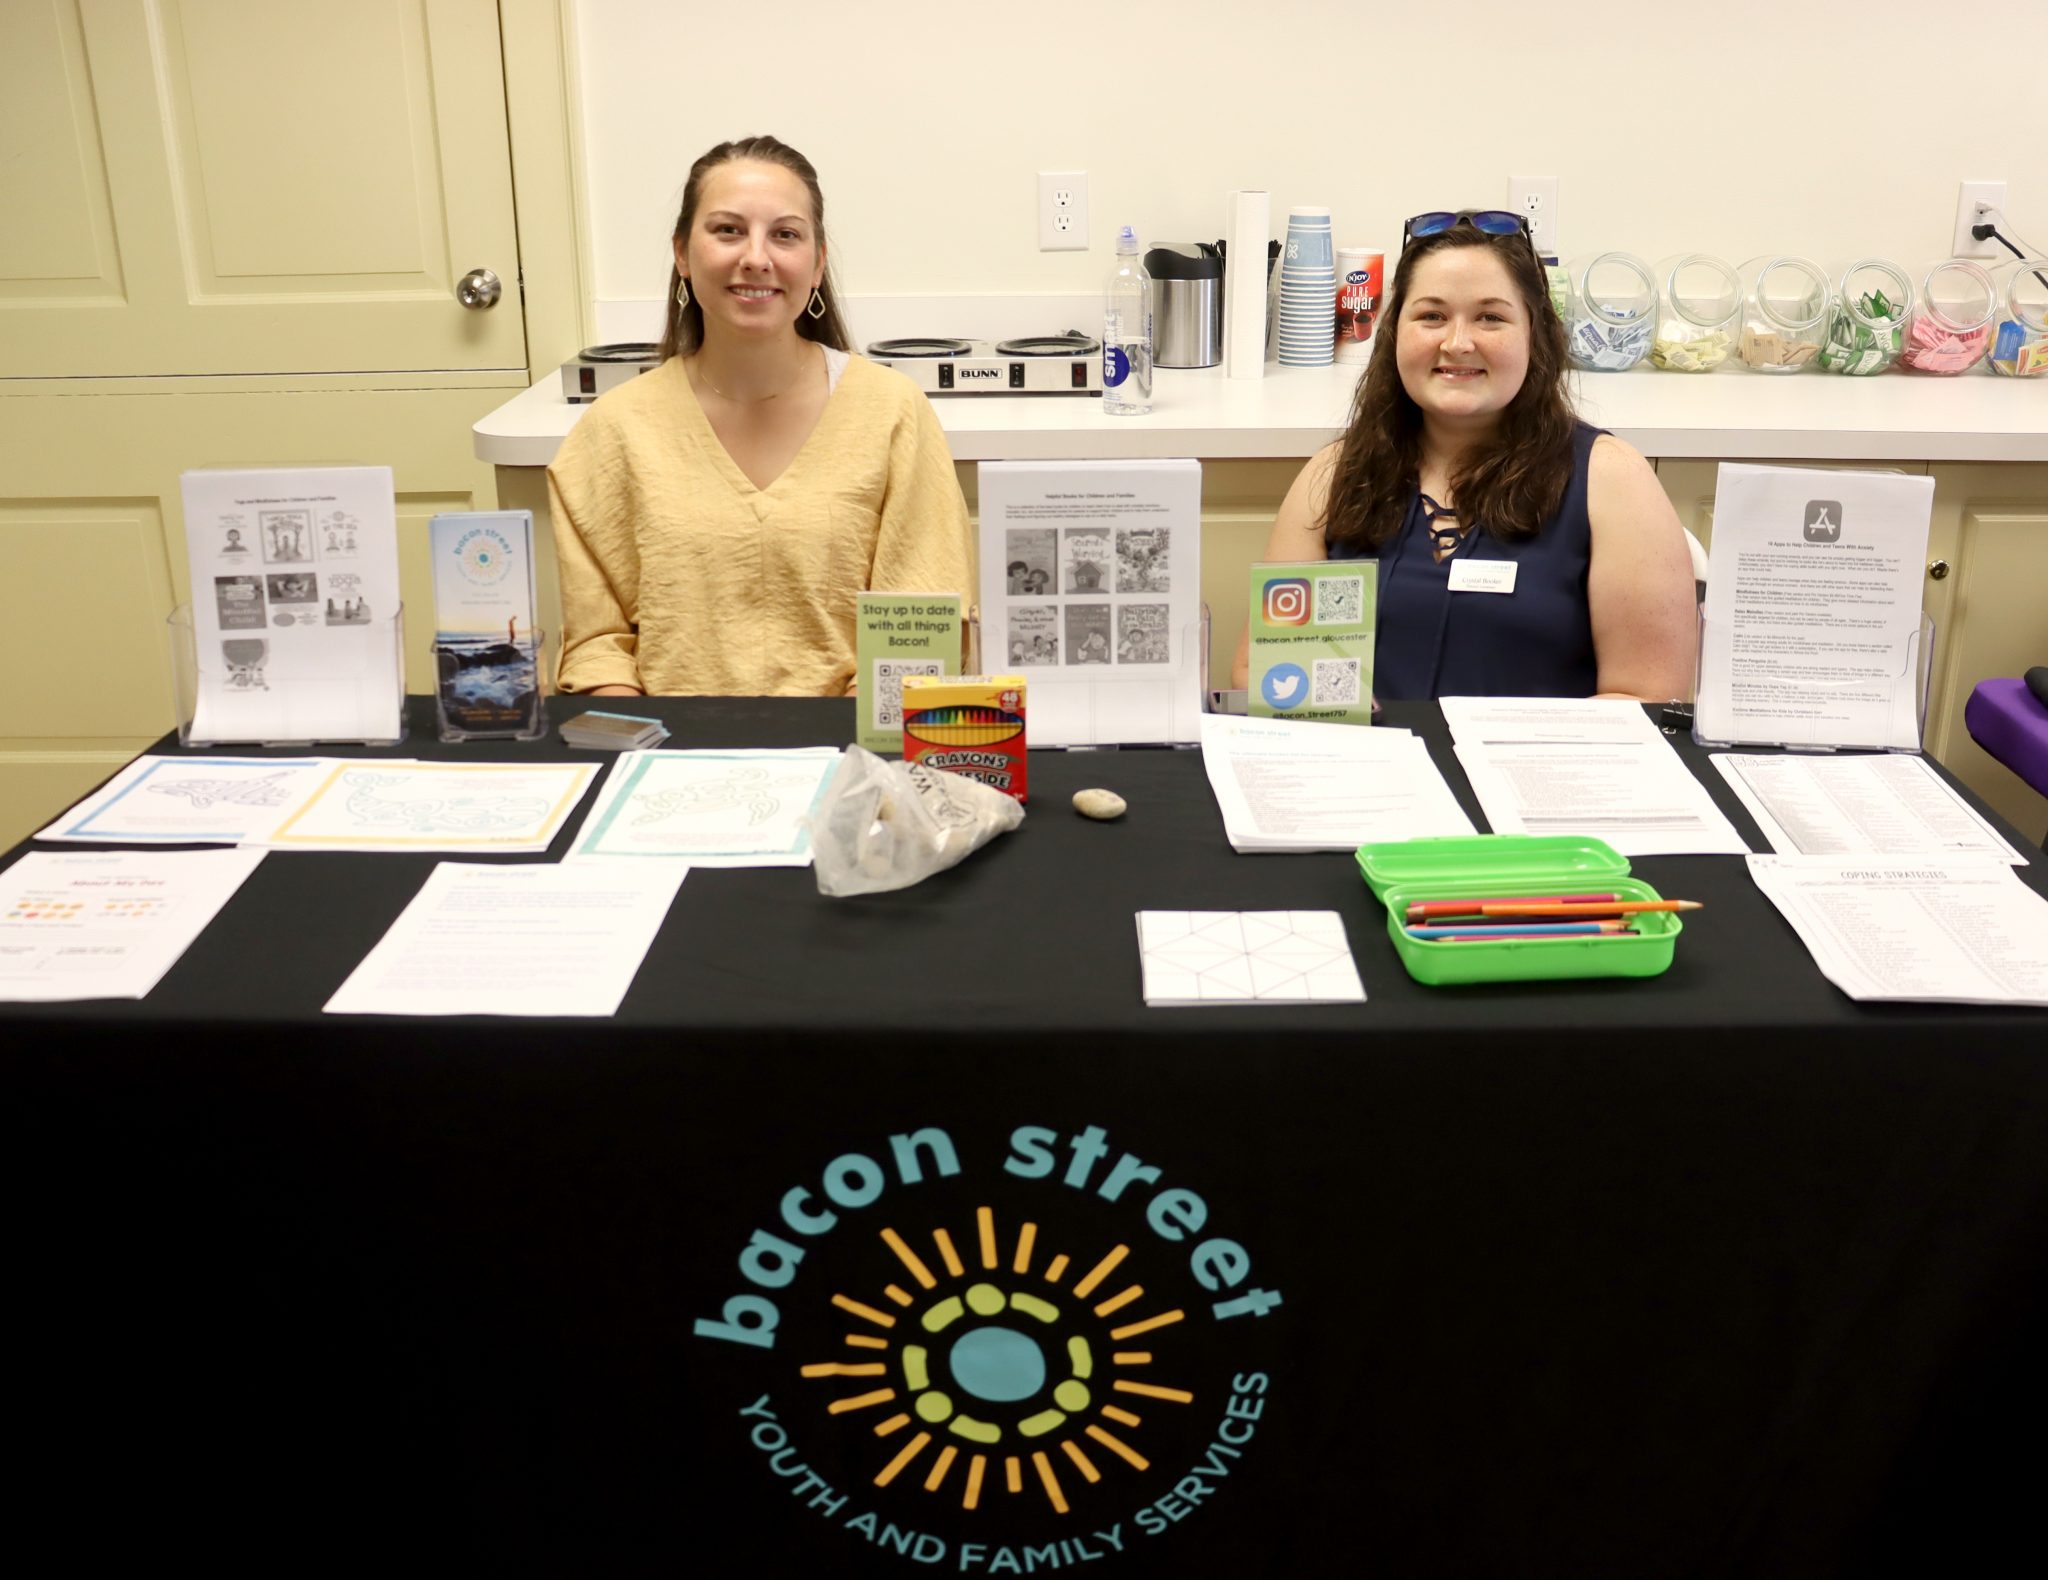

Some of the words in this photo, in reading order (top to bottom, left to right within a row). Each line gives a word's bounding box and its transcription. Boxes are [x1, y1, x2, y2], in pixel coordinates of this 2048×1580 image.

[1346, 286, 1369, 297] PURE
[1341, 295, 1374, 314] sugar
[1103, 313, 1116, 378] smart
[961, 370, 999, 378] BUNN
[863, 604, 890, 617] Stay
[893, 606, 908, 617] up
[911, 605, 924, 615] to
[926, 605, 955, 616] date
[868, 620, 894, 631] with
[896, 620, 911, 631] all
[914, 620, 951, 634] things
[888, 636, 930, 647] Bacon!
[1001, 691, 1018, 702] 48
[924, 752, 1008, 769] CRAYONS
[1841, 871, 1881, 879] COPING
[1884, 871, 1948, 879] STRATEGIES
[694, 1126, 961, 1349] bacon
[1003, 1125, 1283, 1320] street
[739, 1394, 849, 1518] YOUTH
[845, 1511, 947, 1564] AND
[960, 1524, 1126, 1575] FAMILY
[1134, 1371, 1269, 1537] SERVICES
